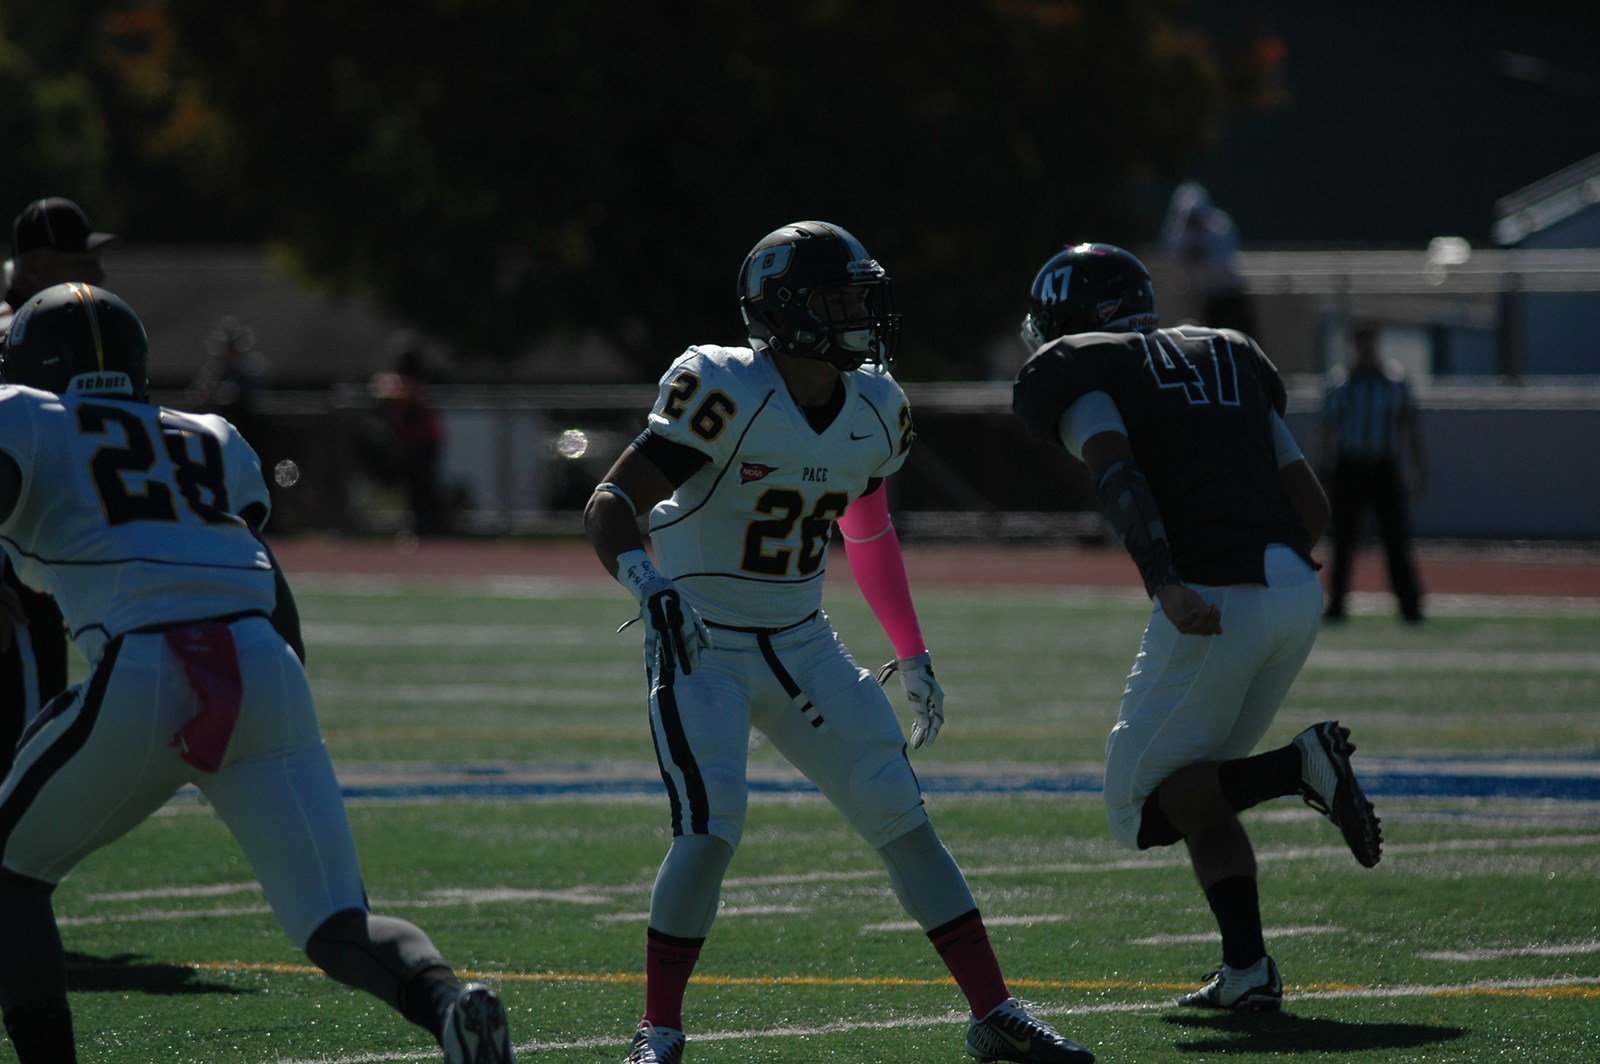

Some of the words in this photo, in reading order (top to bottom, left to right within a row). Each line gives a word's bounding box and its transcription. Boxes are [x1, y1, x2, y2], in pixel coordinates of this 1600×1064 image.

[1041, 265, 1073, 306] 47
[77, 375, 125, 389] schutt
[1135, 328, 1241, 407] 47
[661, 371, 737, 443] 26
[74, 402, 247, 527] 28
[802, 467, 829, 482] PACE
[740, 488, 848, 576] 26
